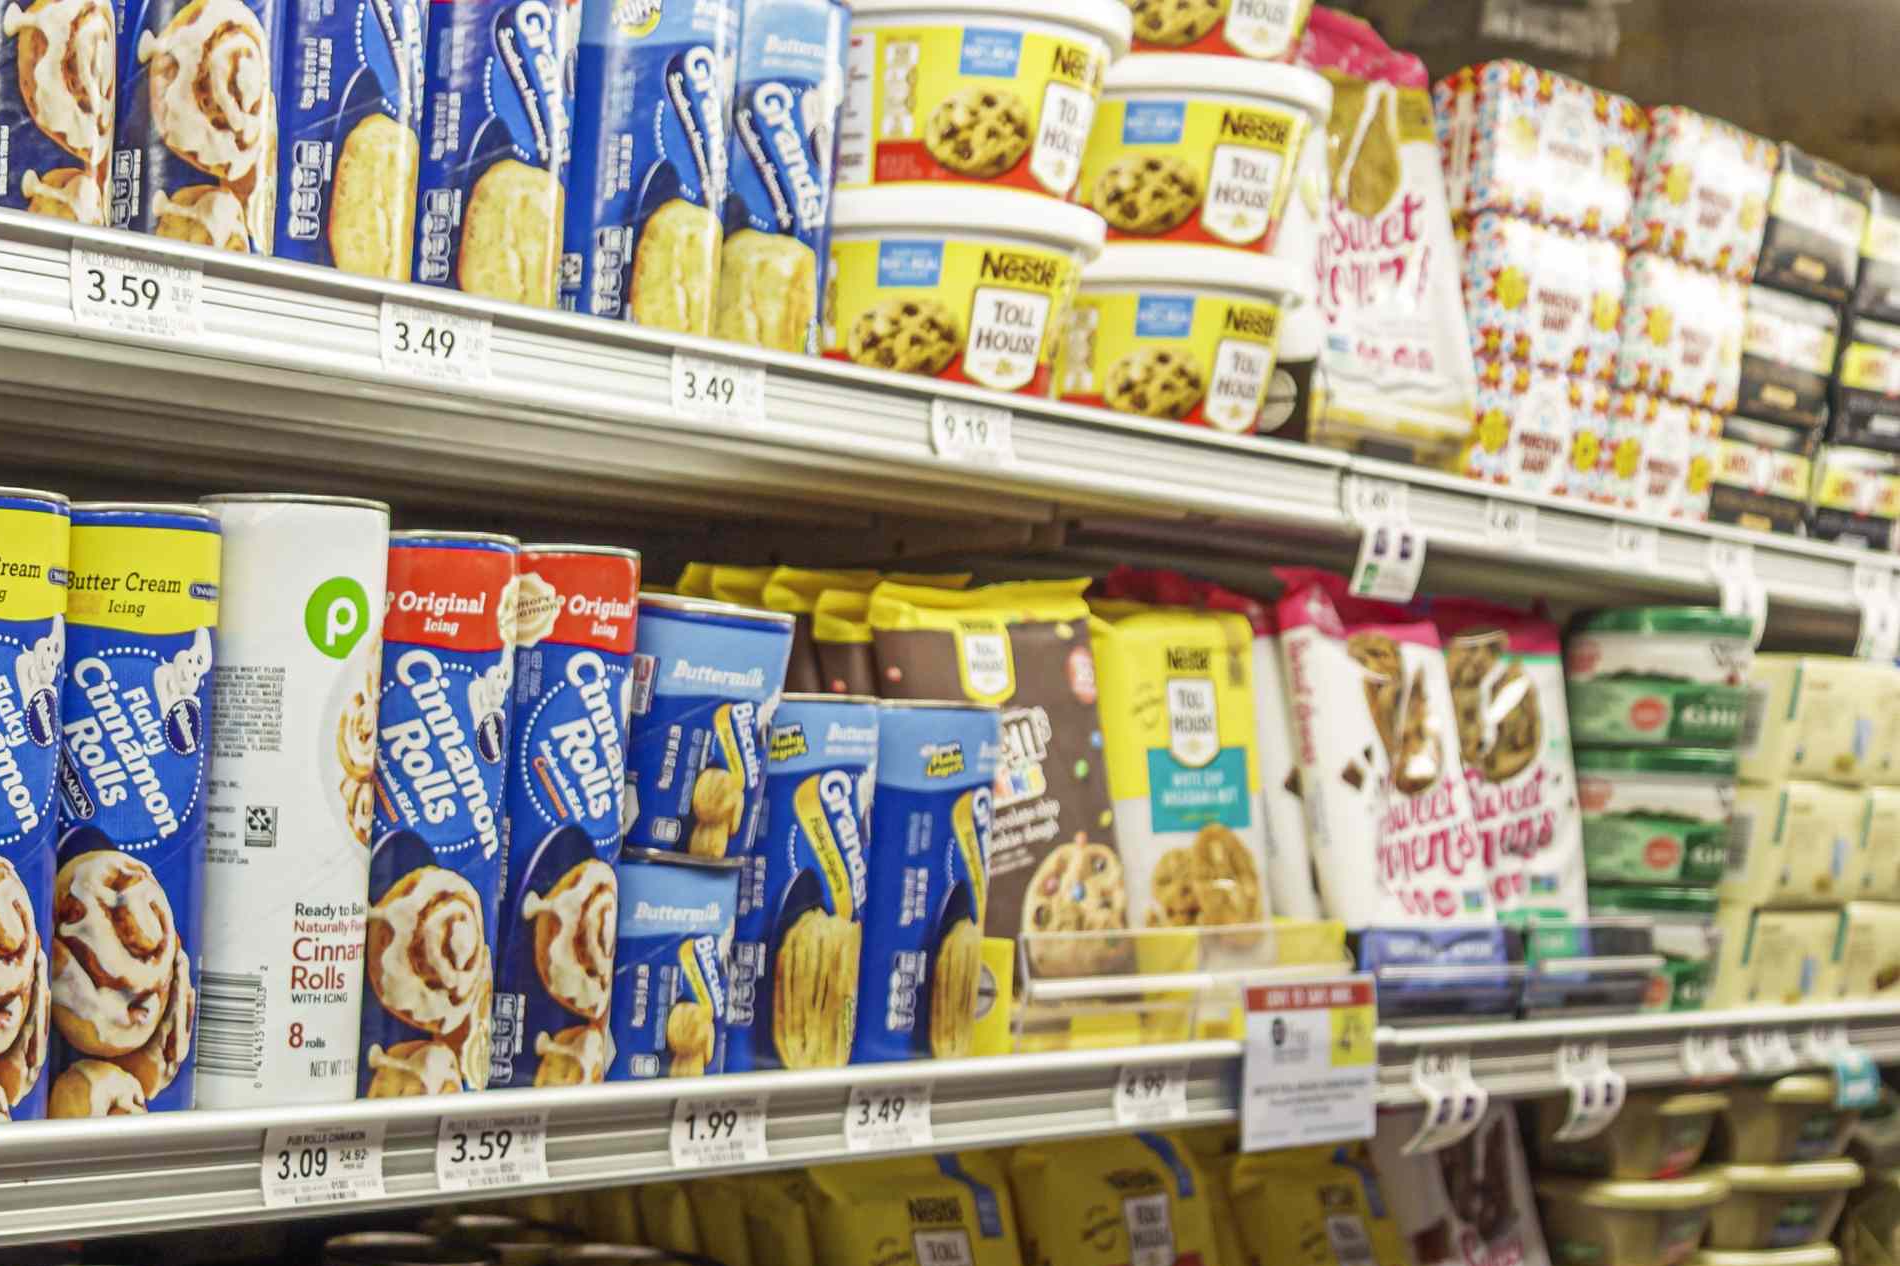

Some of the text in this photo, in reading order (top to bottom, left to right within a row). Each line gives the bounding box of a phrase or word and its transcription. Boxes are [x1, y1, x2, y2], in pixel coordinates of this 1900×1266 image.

[87, 269, 160, 310] 3.59
[394, 322, 455, 359] 3.49
[684, 371, 735, 404] 3.49
[67, 571, 182, 594] Butter Cream
[108, 600, 146, 616] Icing
[398, 590, 485, 616] Original
[673, 661, 765, 688] Buttermilk
[73, 657, 180, 839] Cinnamon
[396, 650, 501, 860] Cinnamon
[731, 701, 760, 787] Biscuits
[63, 718, 127, 807] Rolls
[380, 723, 455, 825] Rolls
[295, 903, 336, 923] Ready
[634, 901, 719, 922] Buttermilk
[291, 966, 345, 990] Rolls
[685, 1109, 737, 1141] 1.99
[858, 1096, 905, 1126] 3.49
[451, 1130, 512, 1163] 3.59
[277, 1147, 328, 1180] 3.09
